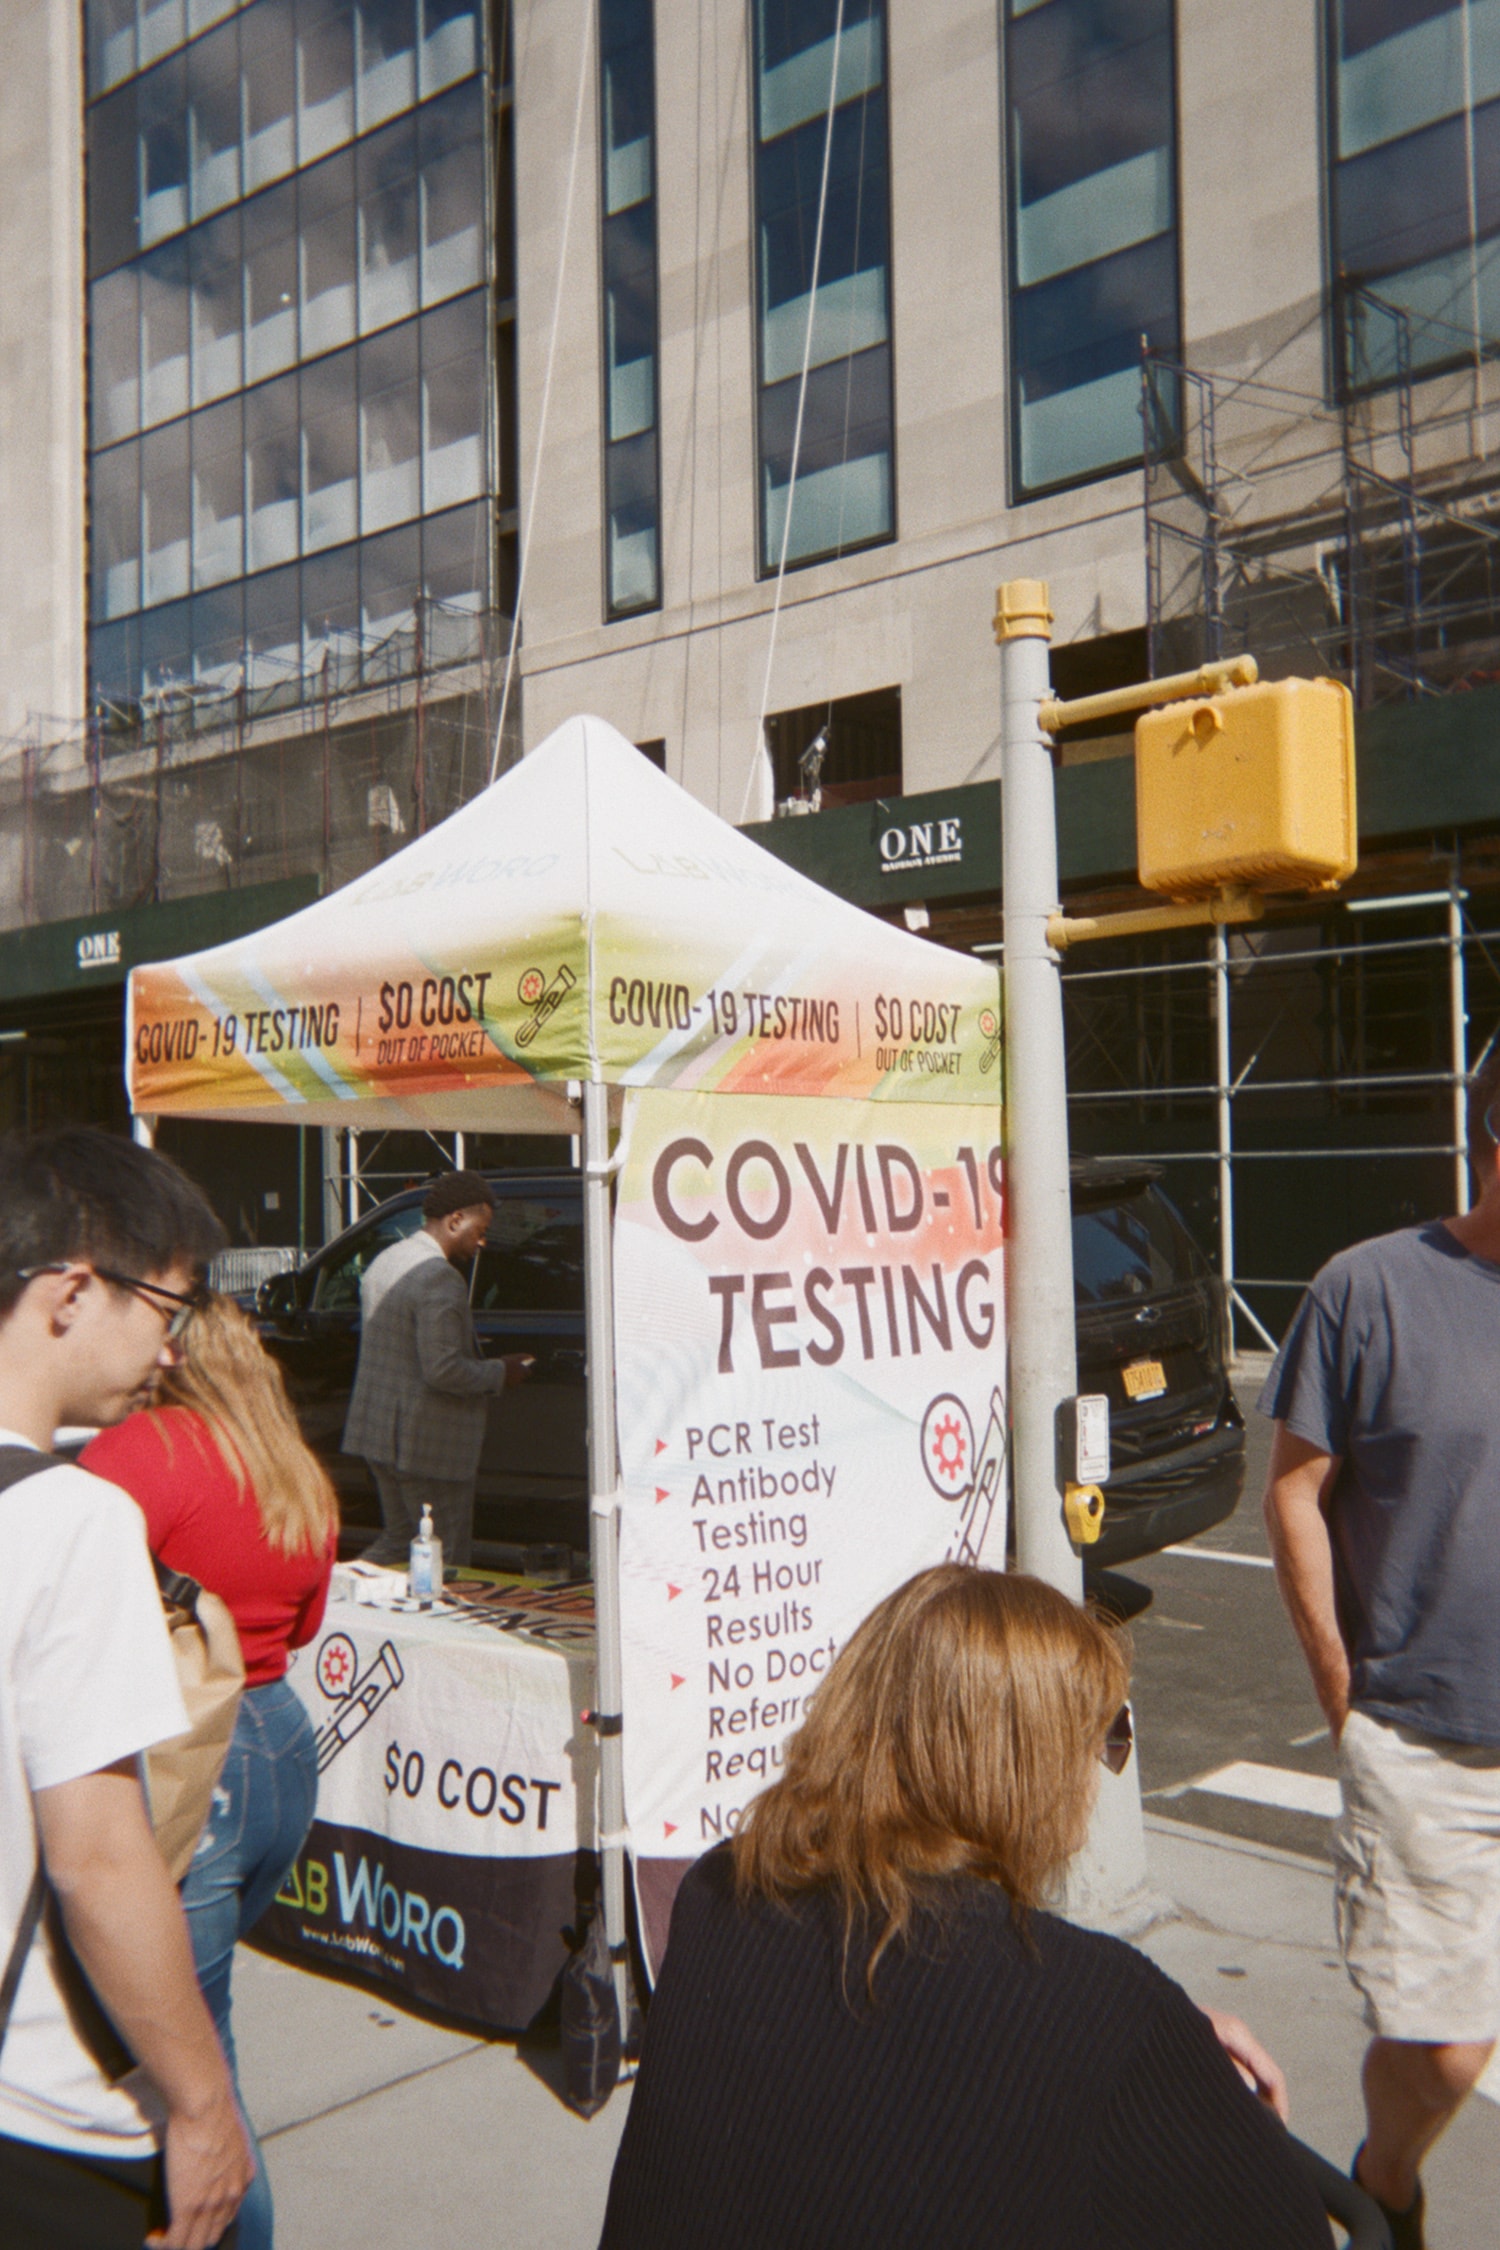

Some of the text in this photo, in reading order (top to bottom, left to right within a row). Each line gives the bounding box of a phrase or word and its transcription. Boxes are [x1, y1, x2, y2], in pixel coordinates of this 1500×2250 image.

[880, 818, 963, 860] ONE
[378, 972, 492, 1033] $0 COST
[609, 976, 840, 1043] COVID-19 TESTING
[874, 993, 961, 1045] $0 COST
[135, 1002, 340, 1065] COVID-19 TESTING
[376, 1028, 490, 1066] OUT OF POCKET
[875, 1049, 961, 1075] OUT OF POCKET
[708, 1258, 995, 1374] TESTING
[686, 1413, 820, 1460] PCR Test
[691, 1459, 836, 1507] Antibody
[692, 1510, 808, 1552] Testing
[702, 1558, 823, 1602] 24 Hour
[706, 1600, 813, 1648] Results
[708, 1637, 838, 1694] No Doct
[708, 1695, 815, 1739] Referr
[383, 1741, 562, 1831] $0 COST
[706, 1745, 785, 1783] Requ
